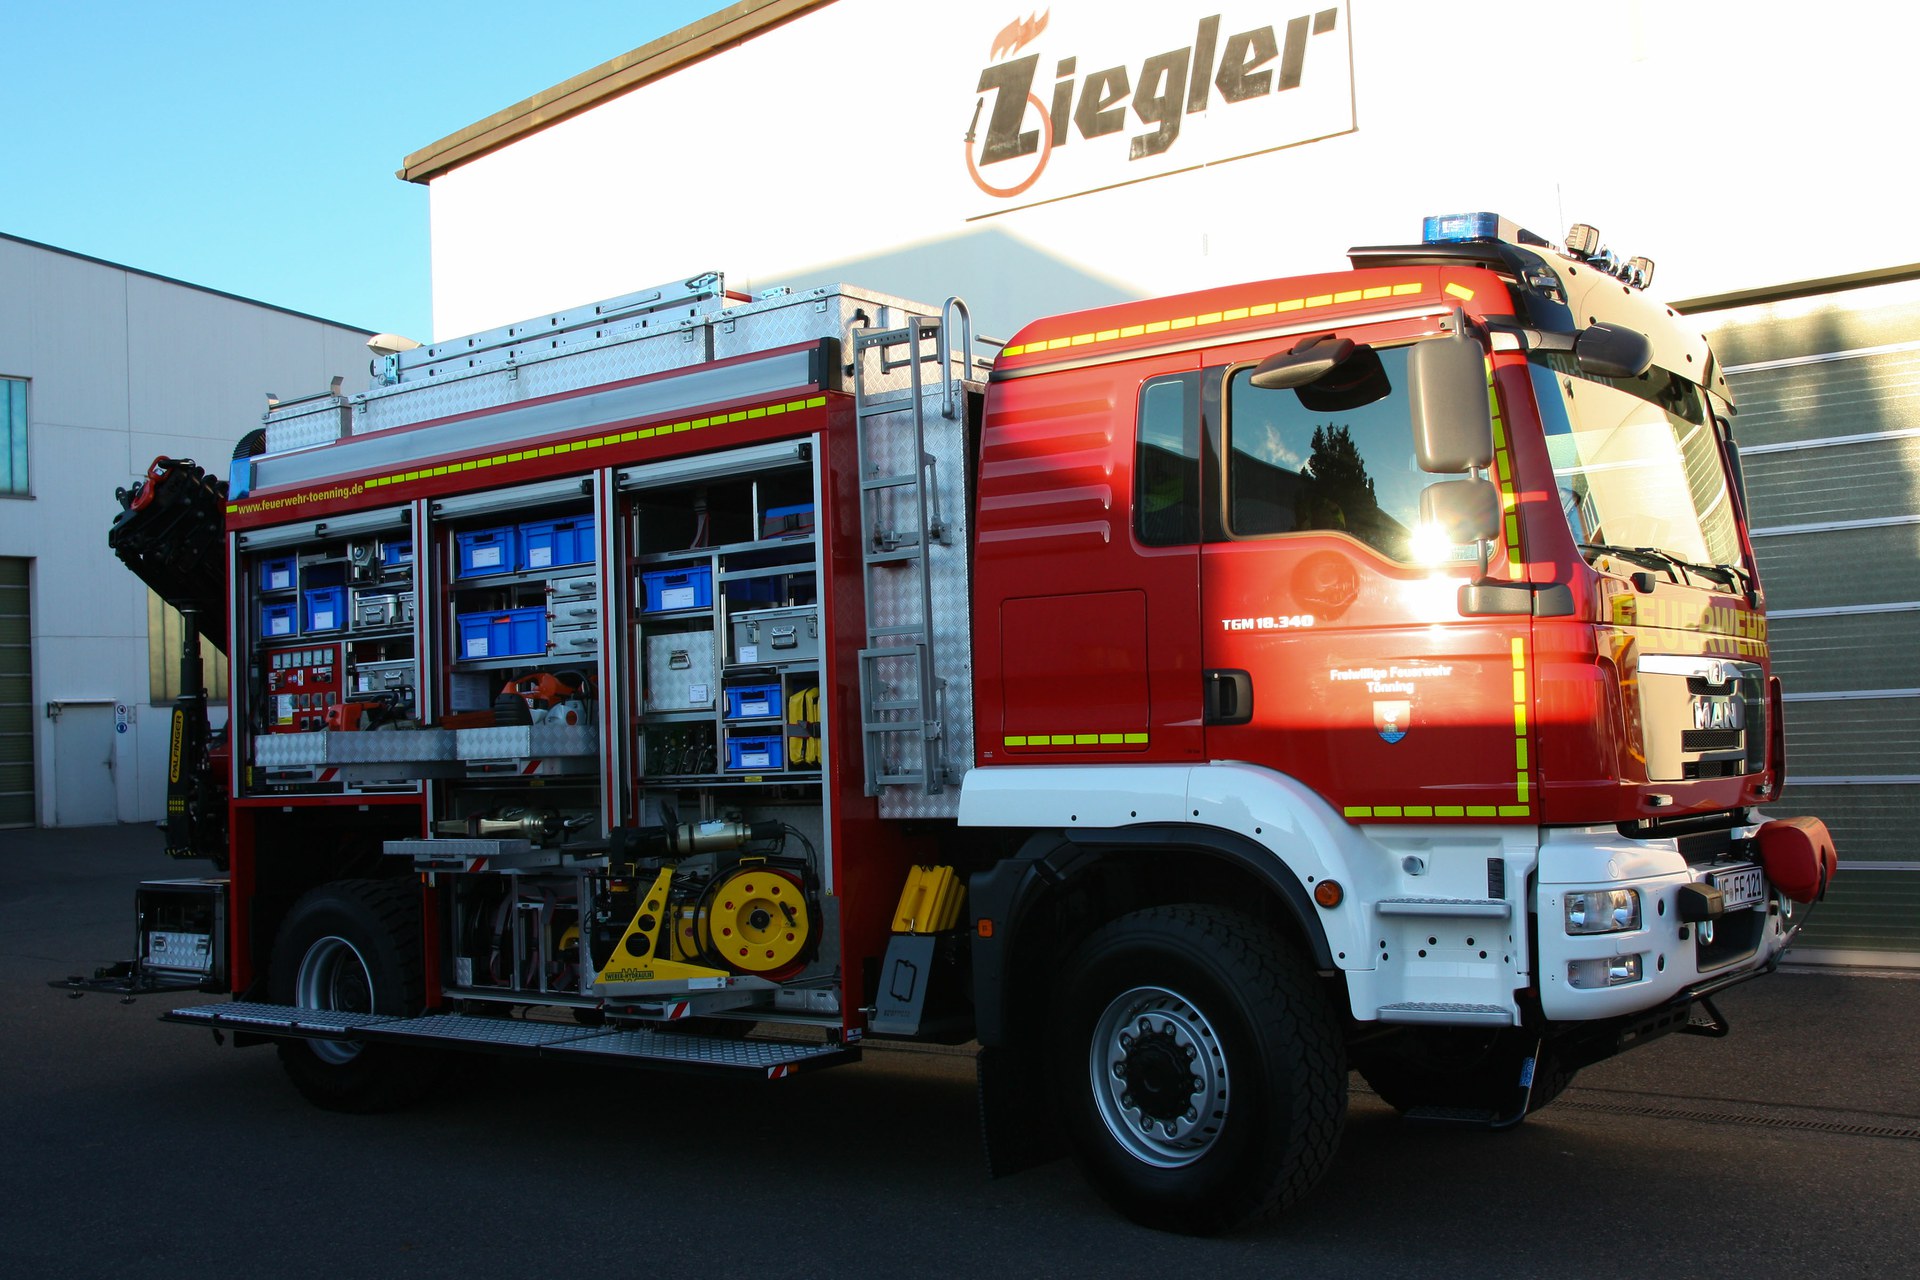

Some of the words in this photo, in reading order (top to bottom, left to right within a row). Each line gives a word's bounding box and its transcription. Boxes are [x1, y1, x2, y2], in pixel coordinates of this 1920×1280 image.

[976, 7, 1337, 166] Ziegler
[238, 483, 364, 514] www.feuerwehr-toenning.de
[1222, 618, 1254, 630] TGM
[1256, 615, 1314, 629] 18.340
[1612, 595, 1769, 658] FEUERWEHR
[1330, 668, 1387, 682] Freiwillige
[1390, 665, 1453, 679] Feuerwehr
[1366, 681, 1414, 694] Tönning
[1694, 701, 1737, 729] MAN
[172, 714, 182, 779] PALFINGER
[1734, 875, 1745, 901] FF
[1746, 872, 1761, 898] 121
